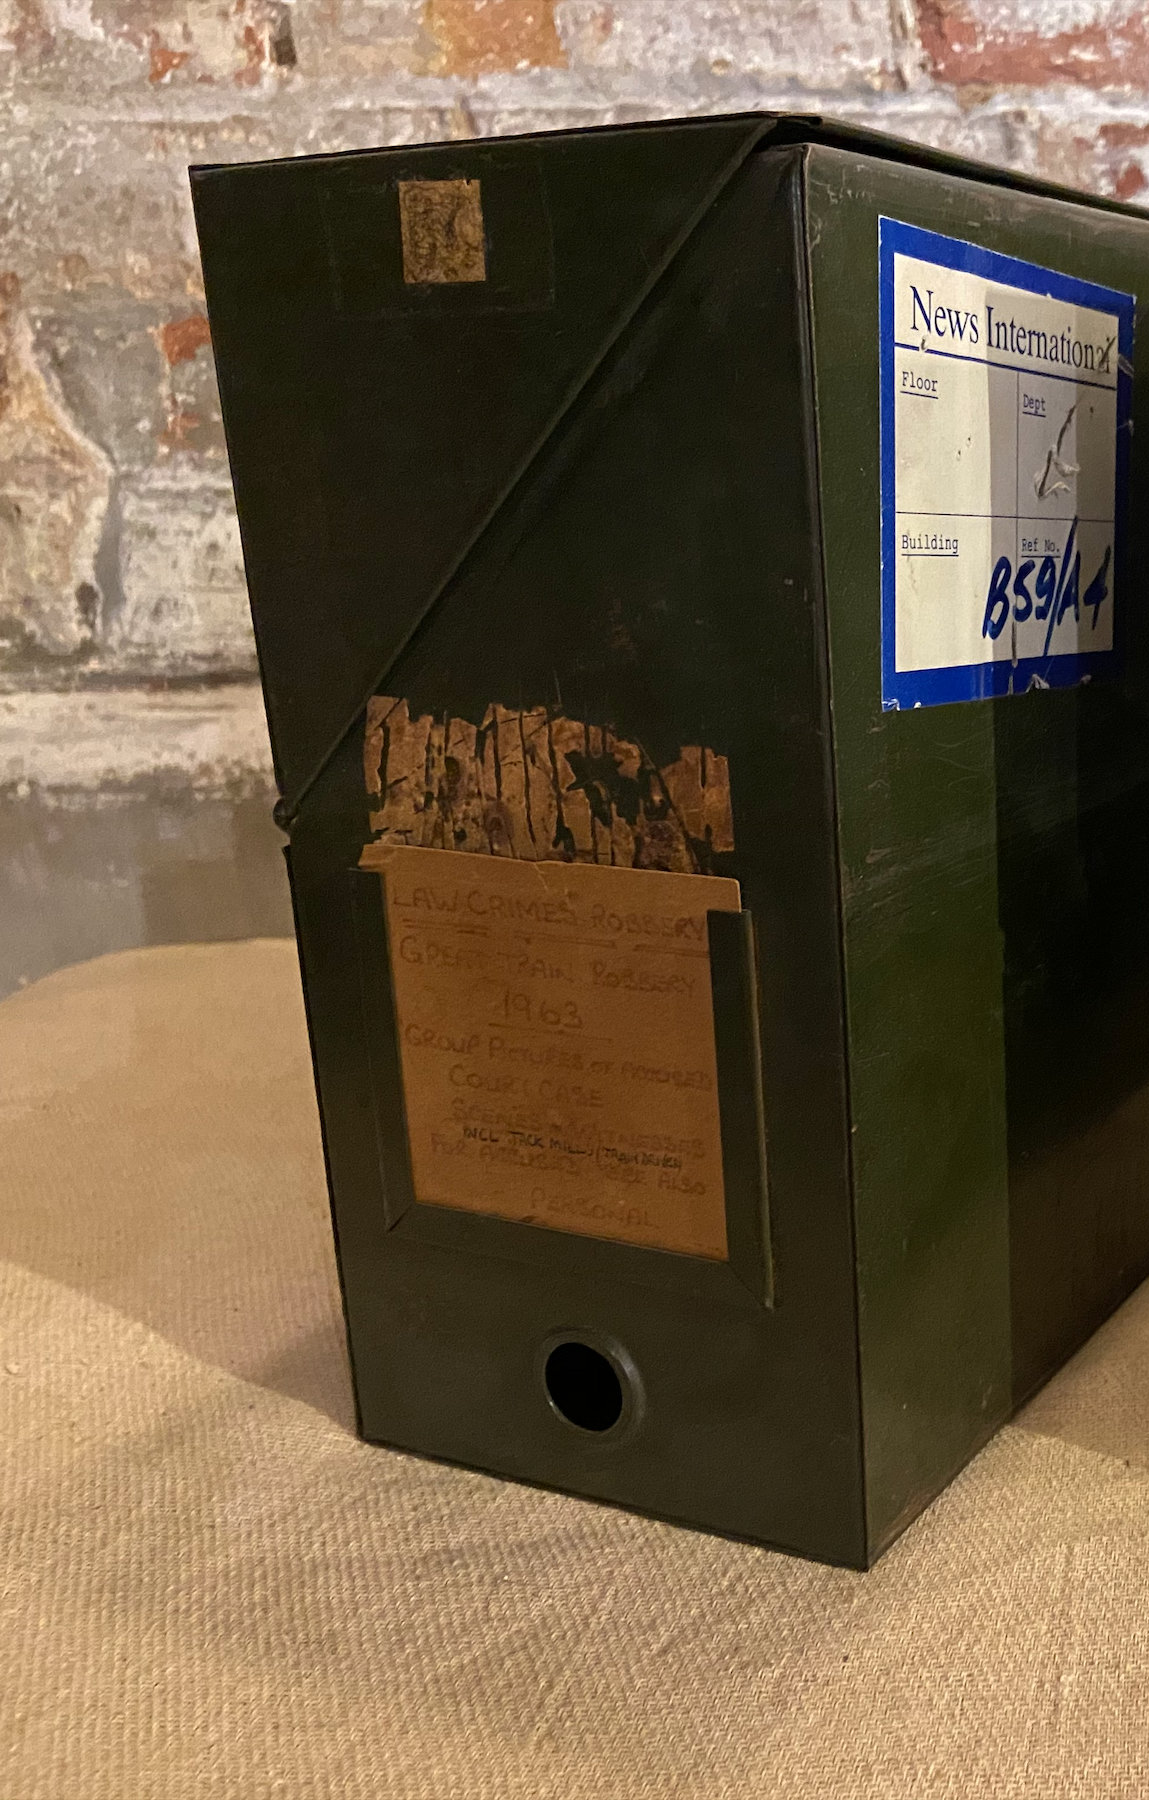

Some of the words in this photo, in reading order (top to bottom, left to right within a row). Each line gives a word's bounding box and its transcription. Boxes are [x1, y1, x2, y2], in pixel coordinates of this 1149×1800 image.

[909, 284, 979, 344] News
[986, 304, 1113, 374] International
[902, 371, 938, 393] Floor
[1022, 394, 1046, 413] Dept
[902, 535, 959, 554] Building
[1021, 538, 1039, 553] Ref
[1044, 538, 1061, 553] No.
[502, 988, 583, 1029] 1963
[405, 1024, 482, 1055] GROUP
